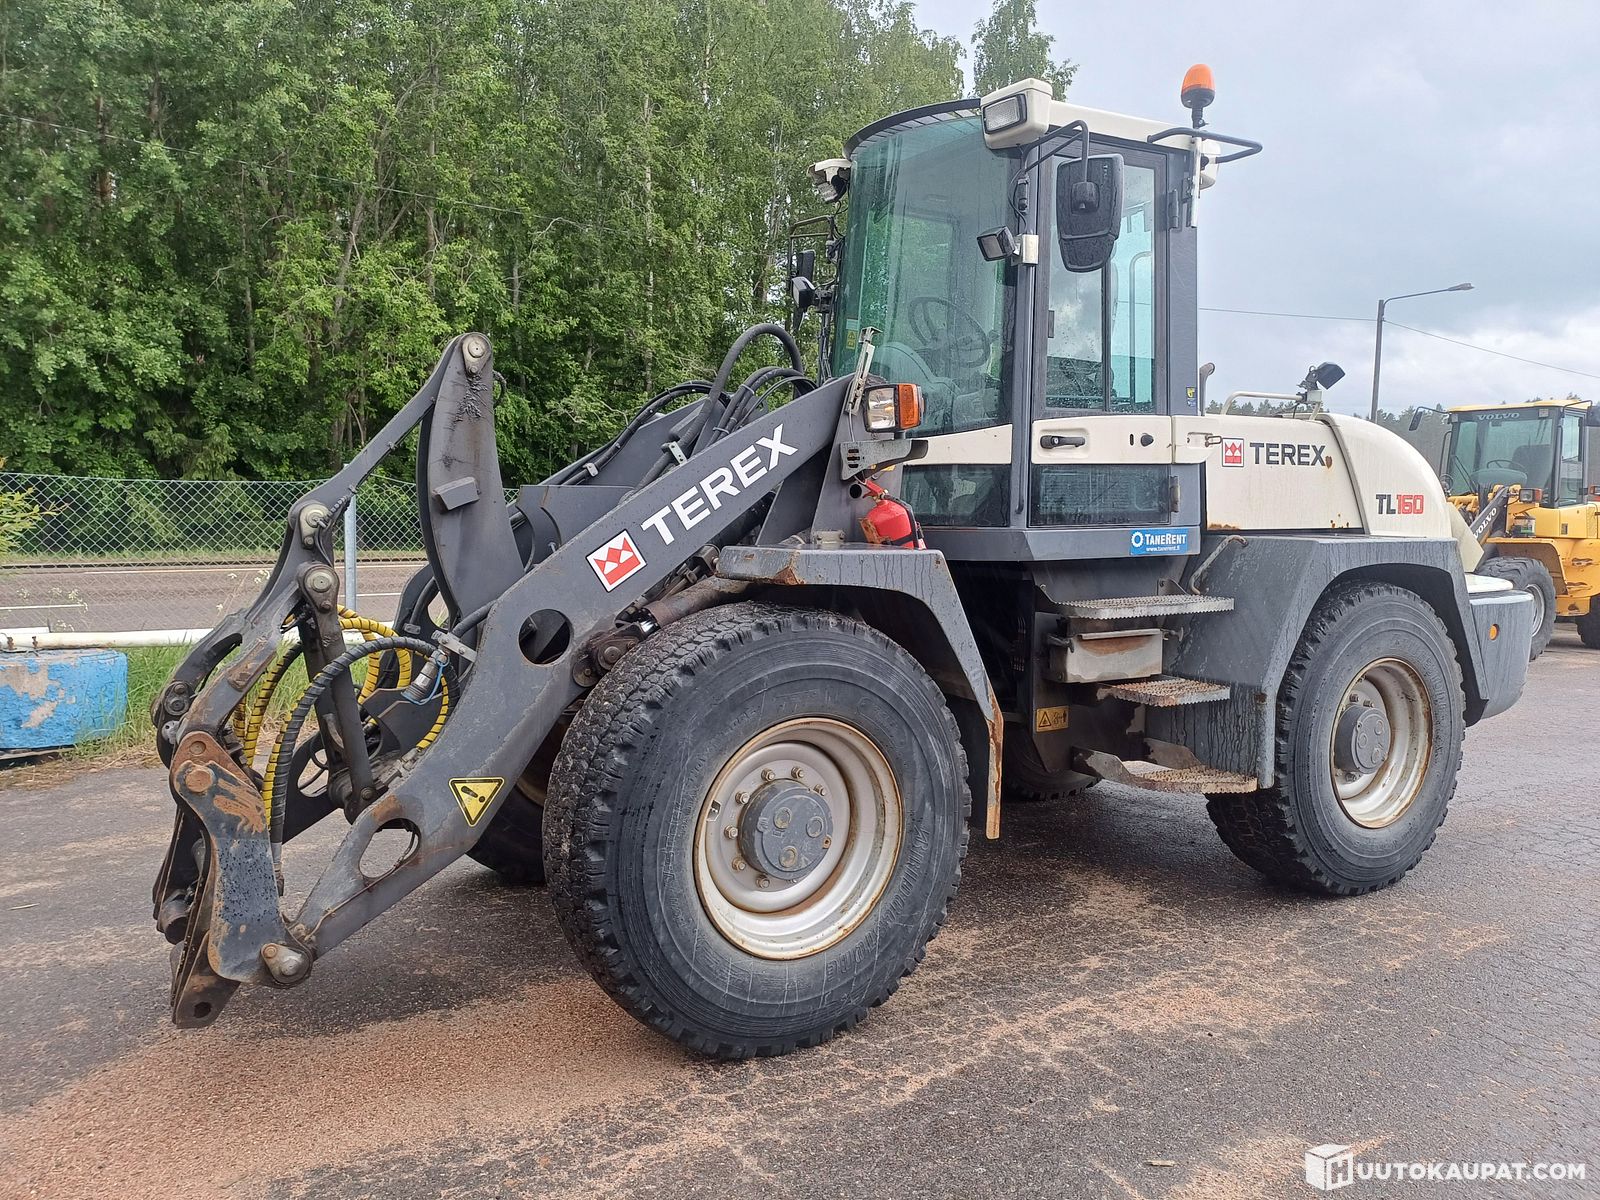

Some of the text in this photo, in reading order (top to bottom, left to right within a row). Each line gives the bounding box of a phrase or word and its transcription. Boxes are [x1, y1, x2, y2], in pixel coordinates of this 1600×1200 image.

[1478, 412, 1520, 421] VOLVO
[1249, 442, 1327, 466] TEREX
[640, 423, 799, 546] TEREX
[1375, 493, 1425, 515] TL160
[1474, 507, 1497, 539] VOLVO
